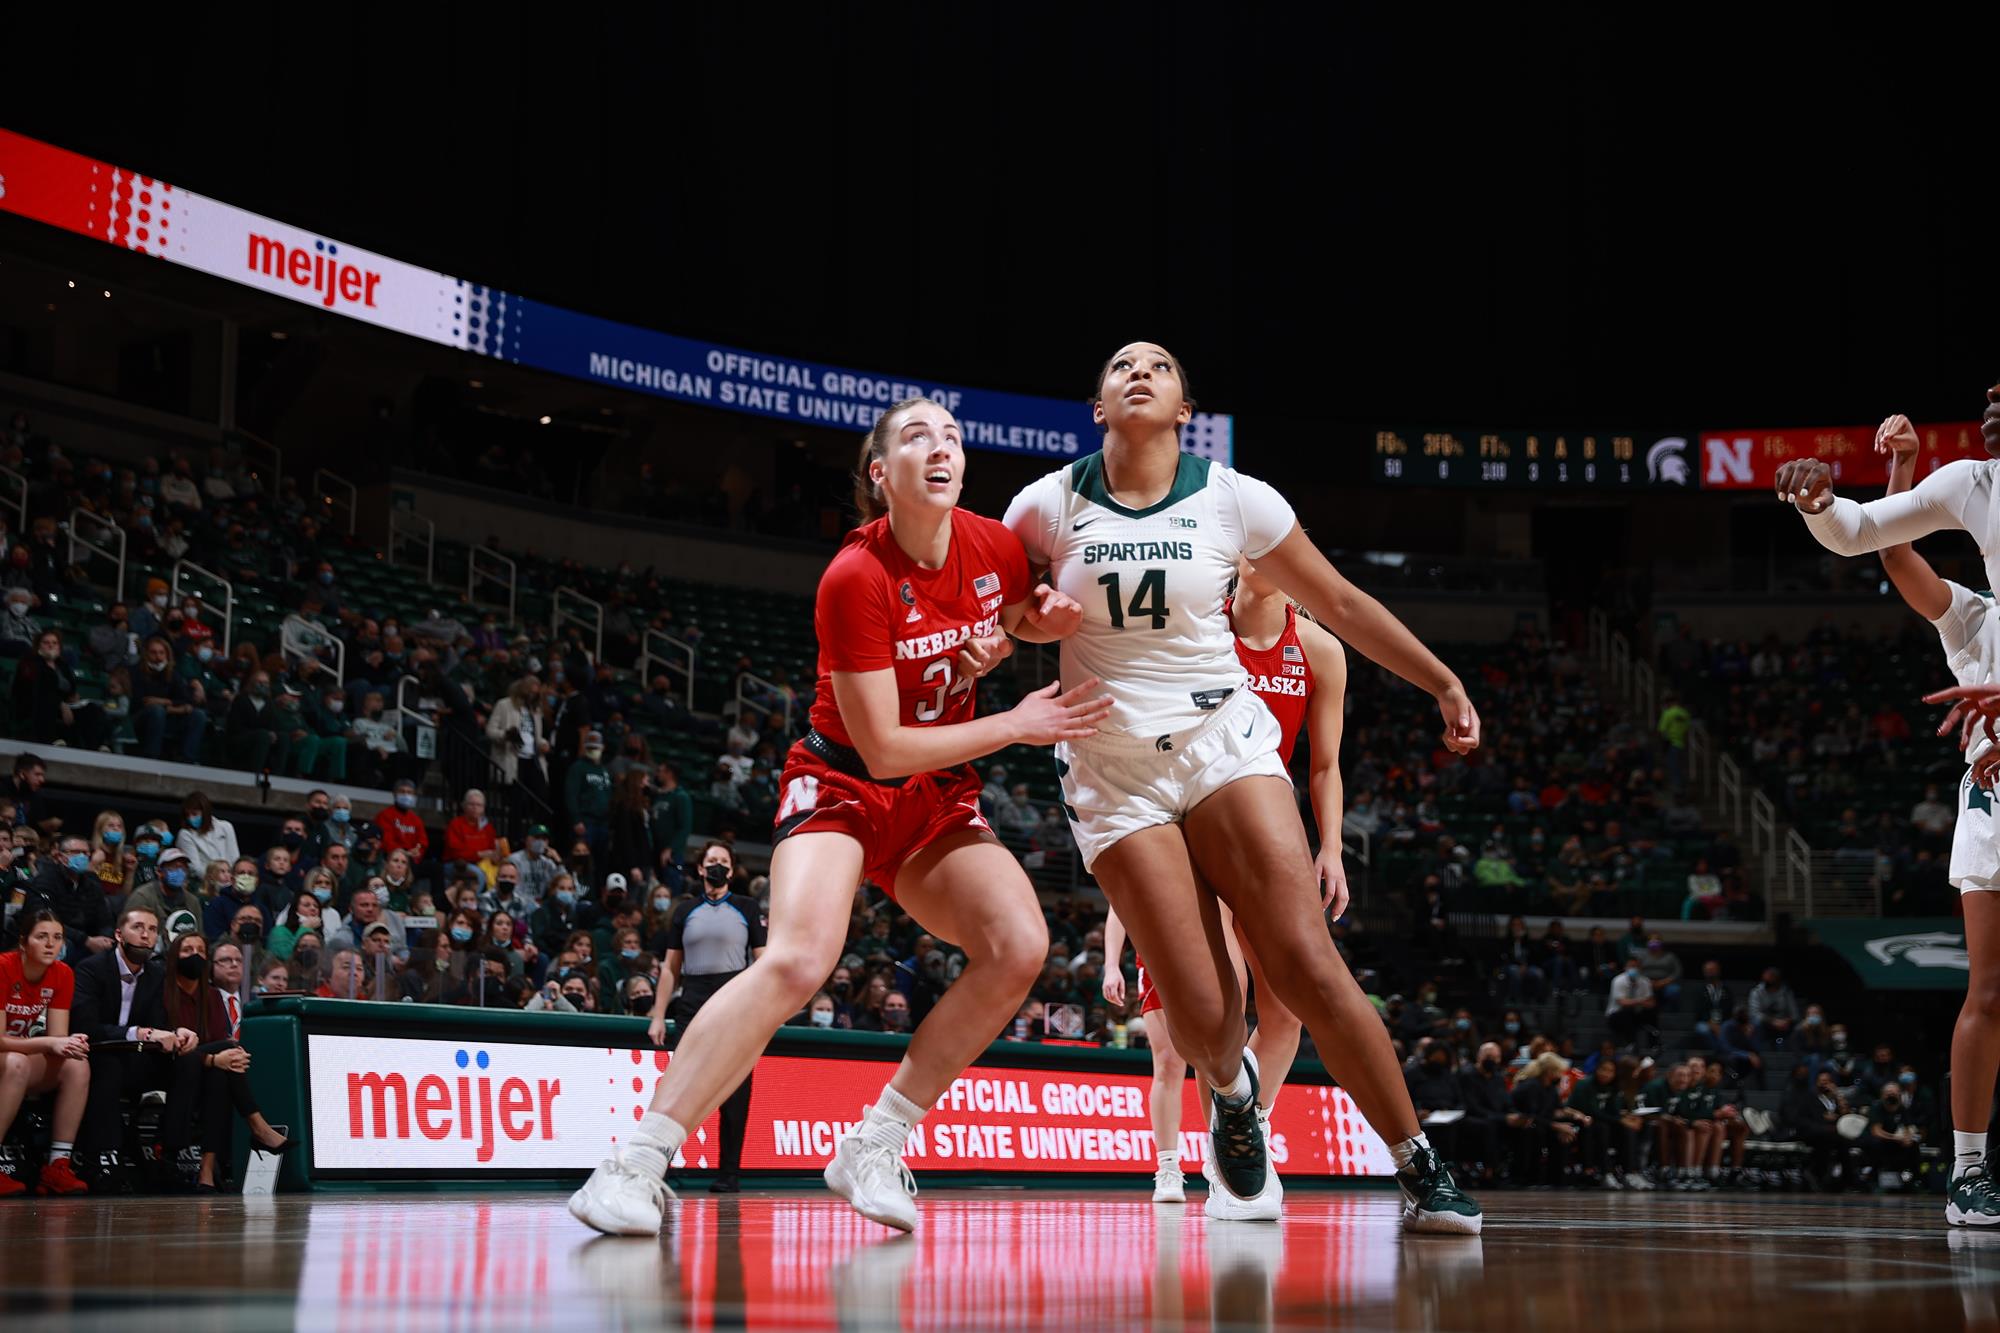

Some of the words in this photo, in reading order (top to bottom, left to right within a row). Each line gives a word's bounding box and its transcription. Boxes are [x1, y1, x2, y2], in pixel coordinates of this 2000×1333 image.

[248, 239, 381, 308] meijer
[589, 352, 712, 399] MICHIGAN
[719, 381, 791, 413] STATE
[797, 394, 887, 427] UNIVER
[706, 350, 816, 390] OFFICIAL
[1706, 439, 1754, 483] N
[1083, 541, 1193, 565] SPARTANS
[1097, 569, 1170, 630] 14
[1246, 674, 1306, 697] RASKA
[347, 1049, 561, 1163] meijer
[935, 1078, 1038, 1114] FFICIAL
[1042, 1081, 1145, 1118] GROCER
[773, 1120, 927, 1158] MICHN
[934, 1124, 1015, 1159] STATE
